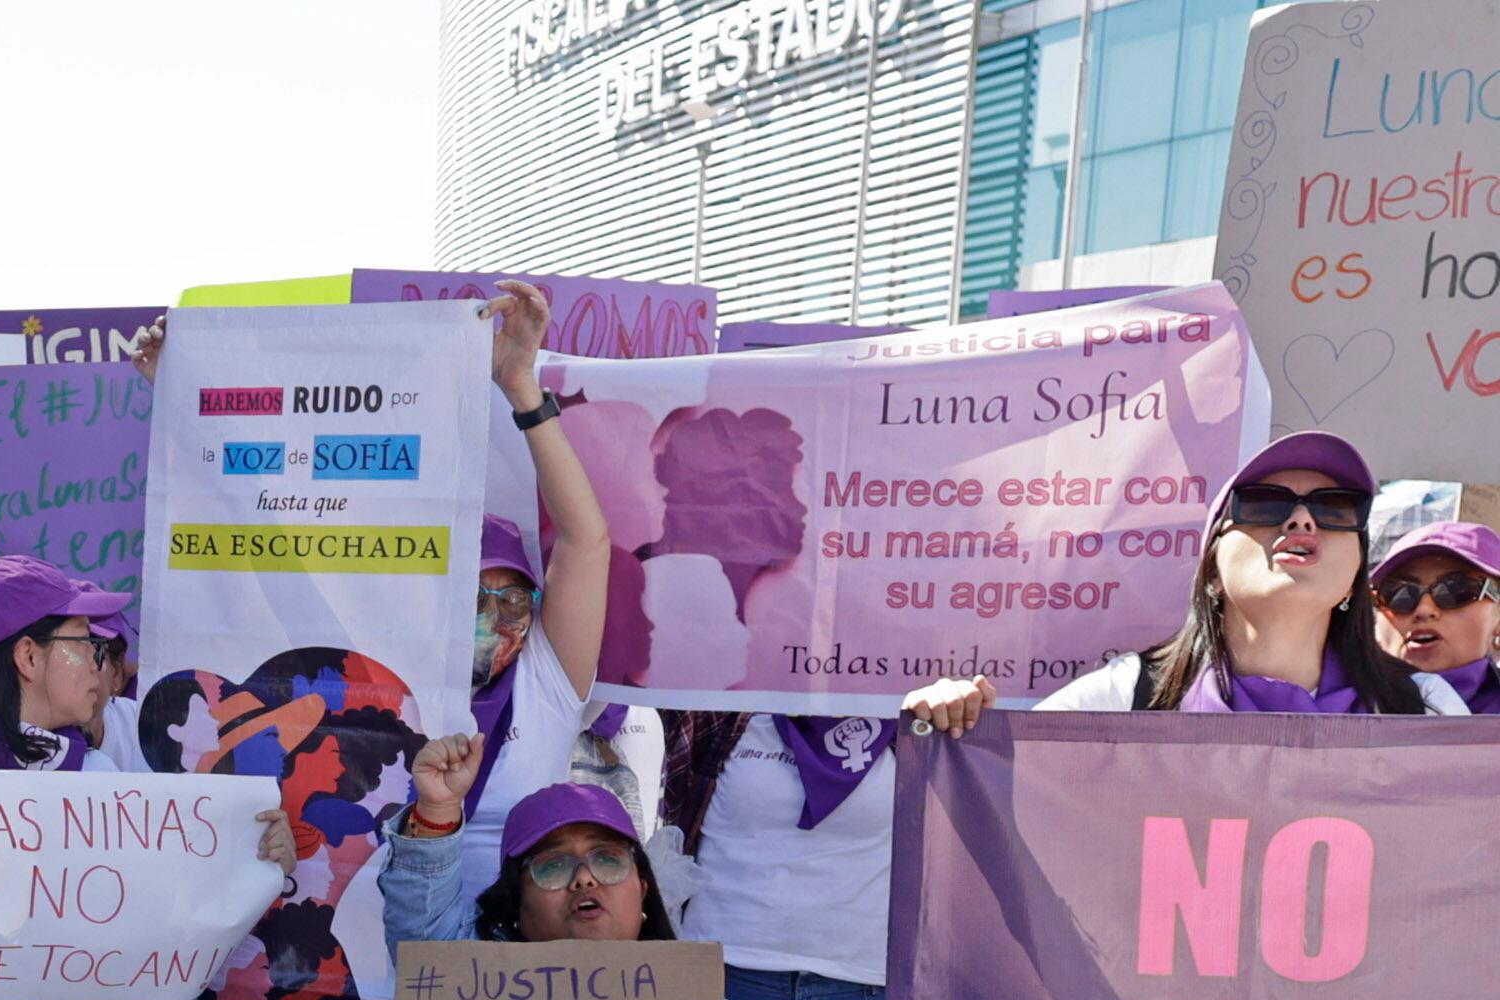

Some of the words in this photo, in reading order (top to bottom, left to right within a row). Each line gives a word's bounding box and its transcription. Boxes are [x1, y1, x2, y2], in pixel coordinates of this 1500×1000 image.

[602, 44, 676, 134] DEL
[1291, 252, 1373, 303] es
[847, 325, 1062, 361] Justicia
[1083, 312, 1211, 356] para
[200, 391, 281, 411] HAREMOS
[293, 385, 382, 413] RUIDO
[391, 390, 419, 408] por
[879, 381, 1010, 425] Luna
[203, 447, 214, 463] la
[224, 447, 281, 471] VOZ
[288, 448, 308, 465] de
[314, 438, 415, 472] SOFÍA
[257, 489, 307, 512] hasta
[314, 495, 347, 518] que
[825, 471, 984, 507] Merece
[998, 471, 1111, 504] estar
[1124, 475, 1207, 504] con
[171, 533, 218, 556] SEA
[230, 534, 441, 559] ESCUCHADA
[822, 532, 870, 558] su
[885, 523, 1030, 562] mamá,
[1049, 530, 1102, 558] no
[1118, 524, 1200, 558] con
[886, 583, 934, 609] su
[950, 580, 1119, 618] agresor
[783, 643, 889, 676] Todas
[900, 646, 1015, 678] unidas
[1028, 660, 1086, 690] por
[63, 789, 218, 857] NIÑAS
[29, 865, 125, 923] NO
[1137, 816, 1375, 983] NO
[457, 959, 656, 1000] JUSTICIA
